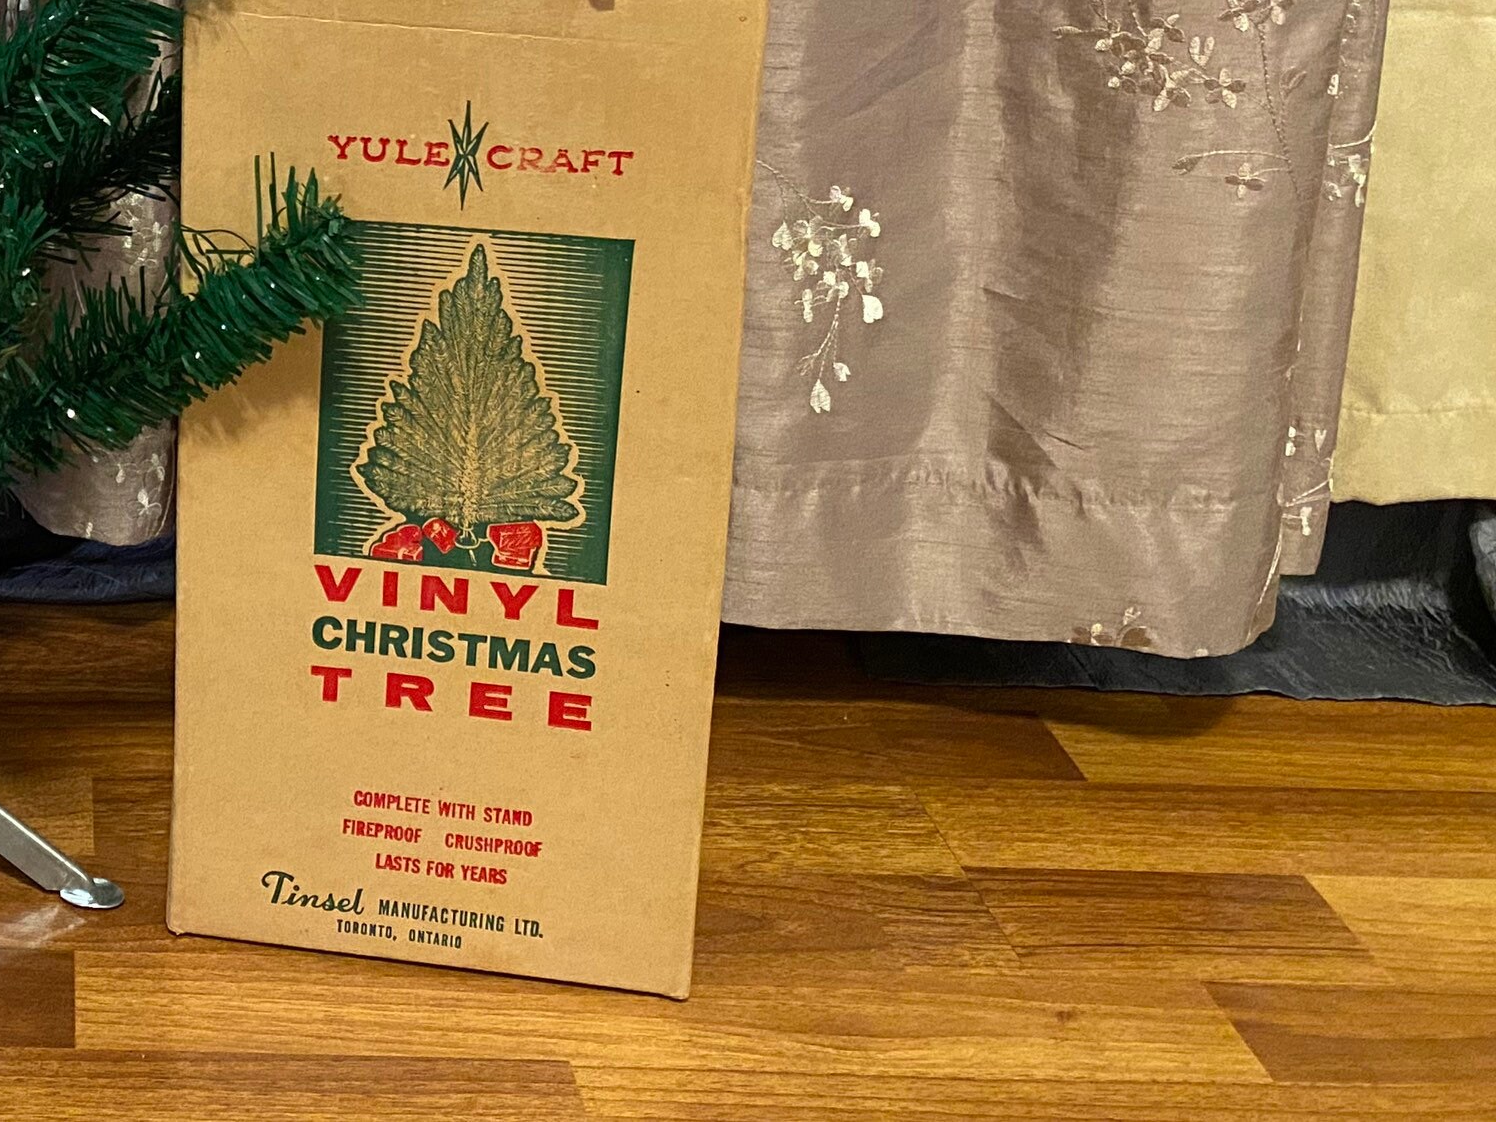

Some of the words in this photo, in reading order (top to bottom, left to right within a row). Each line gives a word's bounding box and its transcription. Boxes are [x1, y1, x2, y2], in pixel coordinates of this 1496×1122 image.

[327, 135, 450, 166] YULE
[486, 145, 634, 176] CRAFT
[313, 564, 599, 630] VINYL
[311, 615, 597, 679] CHRISTMAS
[310, 665, 593, 731] TREE
[353, 790, 431, 816] COMPLETE
[437, 799, 476, 821] WITH
[483, 806, 533, 827] STAND
[342, 818, 422, 844] FIREPROOF
[444, 833, 543, 858] CRUSHPROOF
[375, 853, 421, 875] LASTS
[426, 859, 454, 879] FOR
[460, 863, 508, 885] YEARS
[261, 870, 364, 915] Tinsel
[378, 898, 504, 932] MANUFACTURING
[514, 918, 544, 938] LTD.
[336, 919, 398, 942] TORONTO,
[408, 928, 462, 949] ONTARIO
